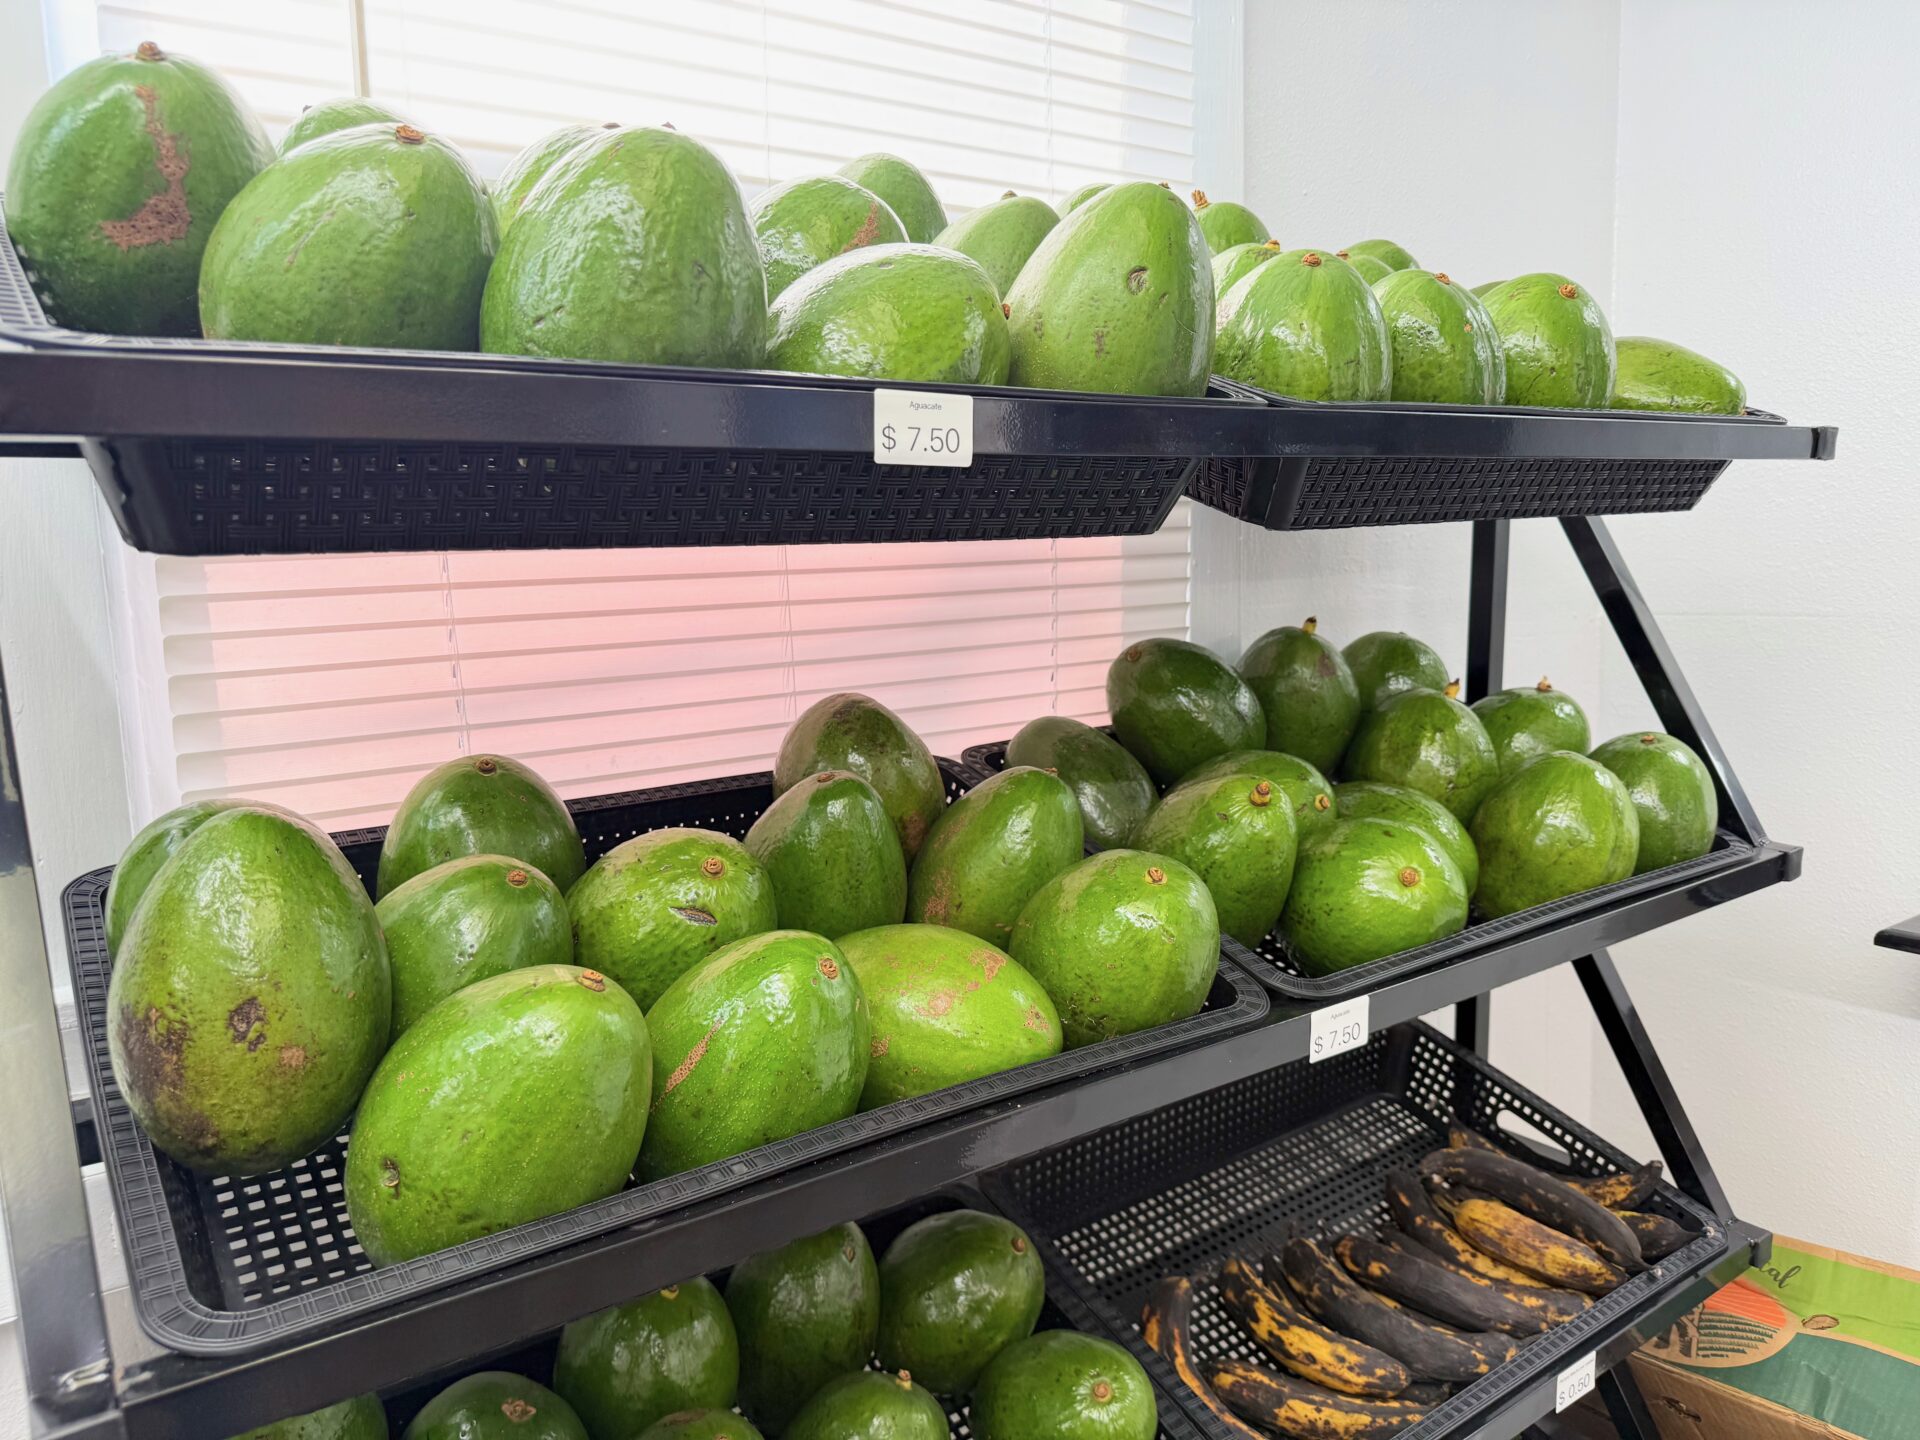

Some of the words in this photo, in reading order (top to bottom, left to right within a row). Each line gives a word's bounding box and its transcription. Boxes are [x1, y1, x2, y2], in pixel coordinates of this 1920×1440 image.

[909, 400, 943, 411] Aguacate
[882, 423, 896, 454] $
[907, 426, 960, 454] 7.50
[1314, 1036, 1323, 1055] $
[1329, 1022, 1361, 1049] 7.50
[1569, 1373, 1590, 1399] 0.50
